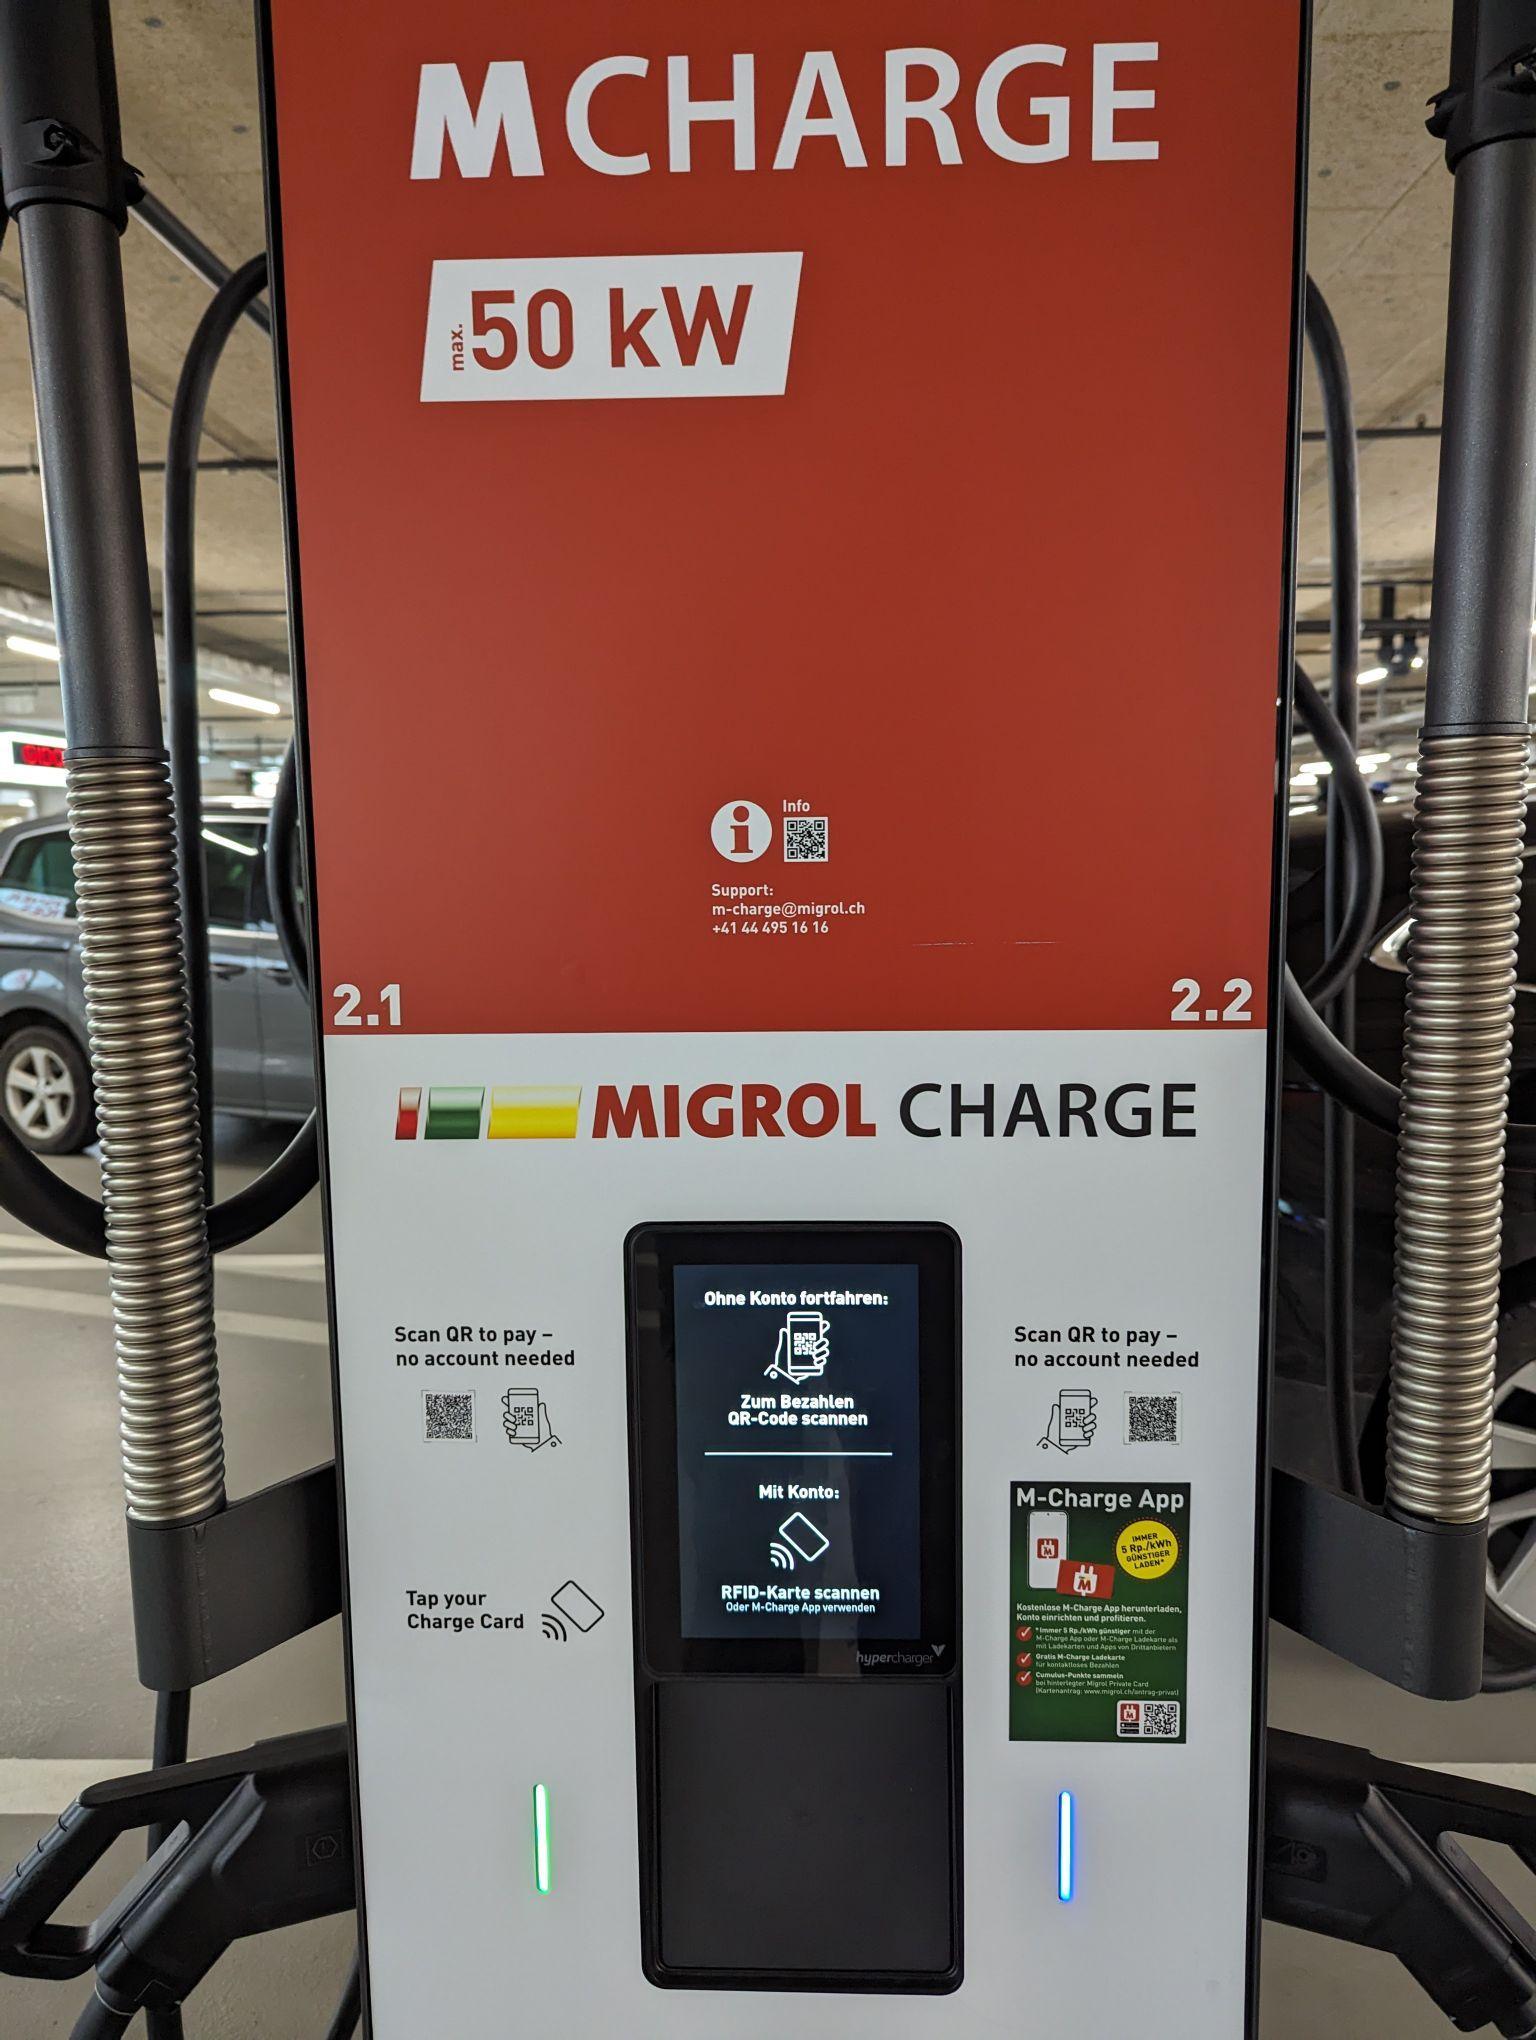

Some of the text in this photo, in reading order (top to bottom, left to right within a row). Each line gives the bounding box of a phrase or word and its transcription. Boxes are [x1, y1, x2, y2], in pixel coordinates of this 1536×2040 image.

[410, 41, 1160, 179] M CHARGE
[450, 283, 754, 371] max. 50 kW
[782, 799, 810, 812] Info
[711, 884, 774, 899] Support:
[712, 901, 865, 918] m-charge@migrol.ch
[712, 920, 829, 934] +41 44 495 16 16
[333, 983, 402, 1027] 2.1
[1170, 978, 1254, 1022] 2.2
[592, 1082, 1197, 1139] MIGROL CHARGE
[704, 1291, 889, 1306] Ohne Konto fortfahren:
[394, 1326, 440, 1343] Scan
[446, 1326, 473, 1343] QR
[479, 1327, 497, 1343] to
[503, 1329, 537, 1346] pay
[1014, 1326, 1061, 1343] Scan
[1068, 1326, 1095, 1343] QR
[1101, 1327, 1120, 1343] to
[1126, 1329, 1161, 1346] pay
[396, 1350, 575, 1367] no account needed
[1015, 1351, 1199, 1367] no account needed
[740, 1394, 854, 1409] Zum Bezahlen
[728, 1411, 868, 1426] QR-Code scannen
[758, 1484, 840, 1499] Mit Konto:
[1016, 1487, 1184, 1513] M-Charge App
[1132, 1533, 1158, 1542] IMMER
[1121, 1539, 1172, 1553] 5 Rp./kWh
[1126, 1550, 1170, 1562] GÜNSTIGER
[406, 1591, 487, 1609] Tap your
[721, 1585, 880, 1600] RFID-Karte scannen
[726, 1602, 876, 1614] Oder M-Charge App verwenden
[1016, 1603, 1182, 1614] Kostenlose M-Charge App herunterladen,
[407, 1614, 524, 1633] Charge Card
[1016, 1613, 1146, 1623] Konto einrichten und profitieren.
[1099, 1628, 1131, 1636] günstiger
[1100, 1636, 1132, 1644] M-Charge
[856, 1651, 934, 1667] hypercharger
[1035, 1653, 1056, 1661] Gratis
[1057, 1654, 1090, 1662] M-Charge
